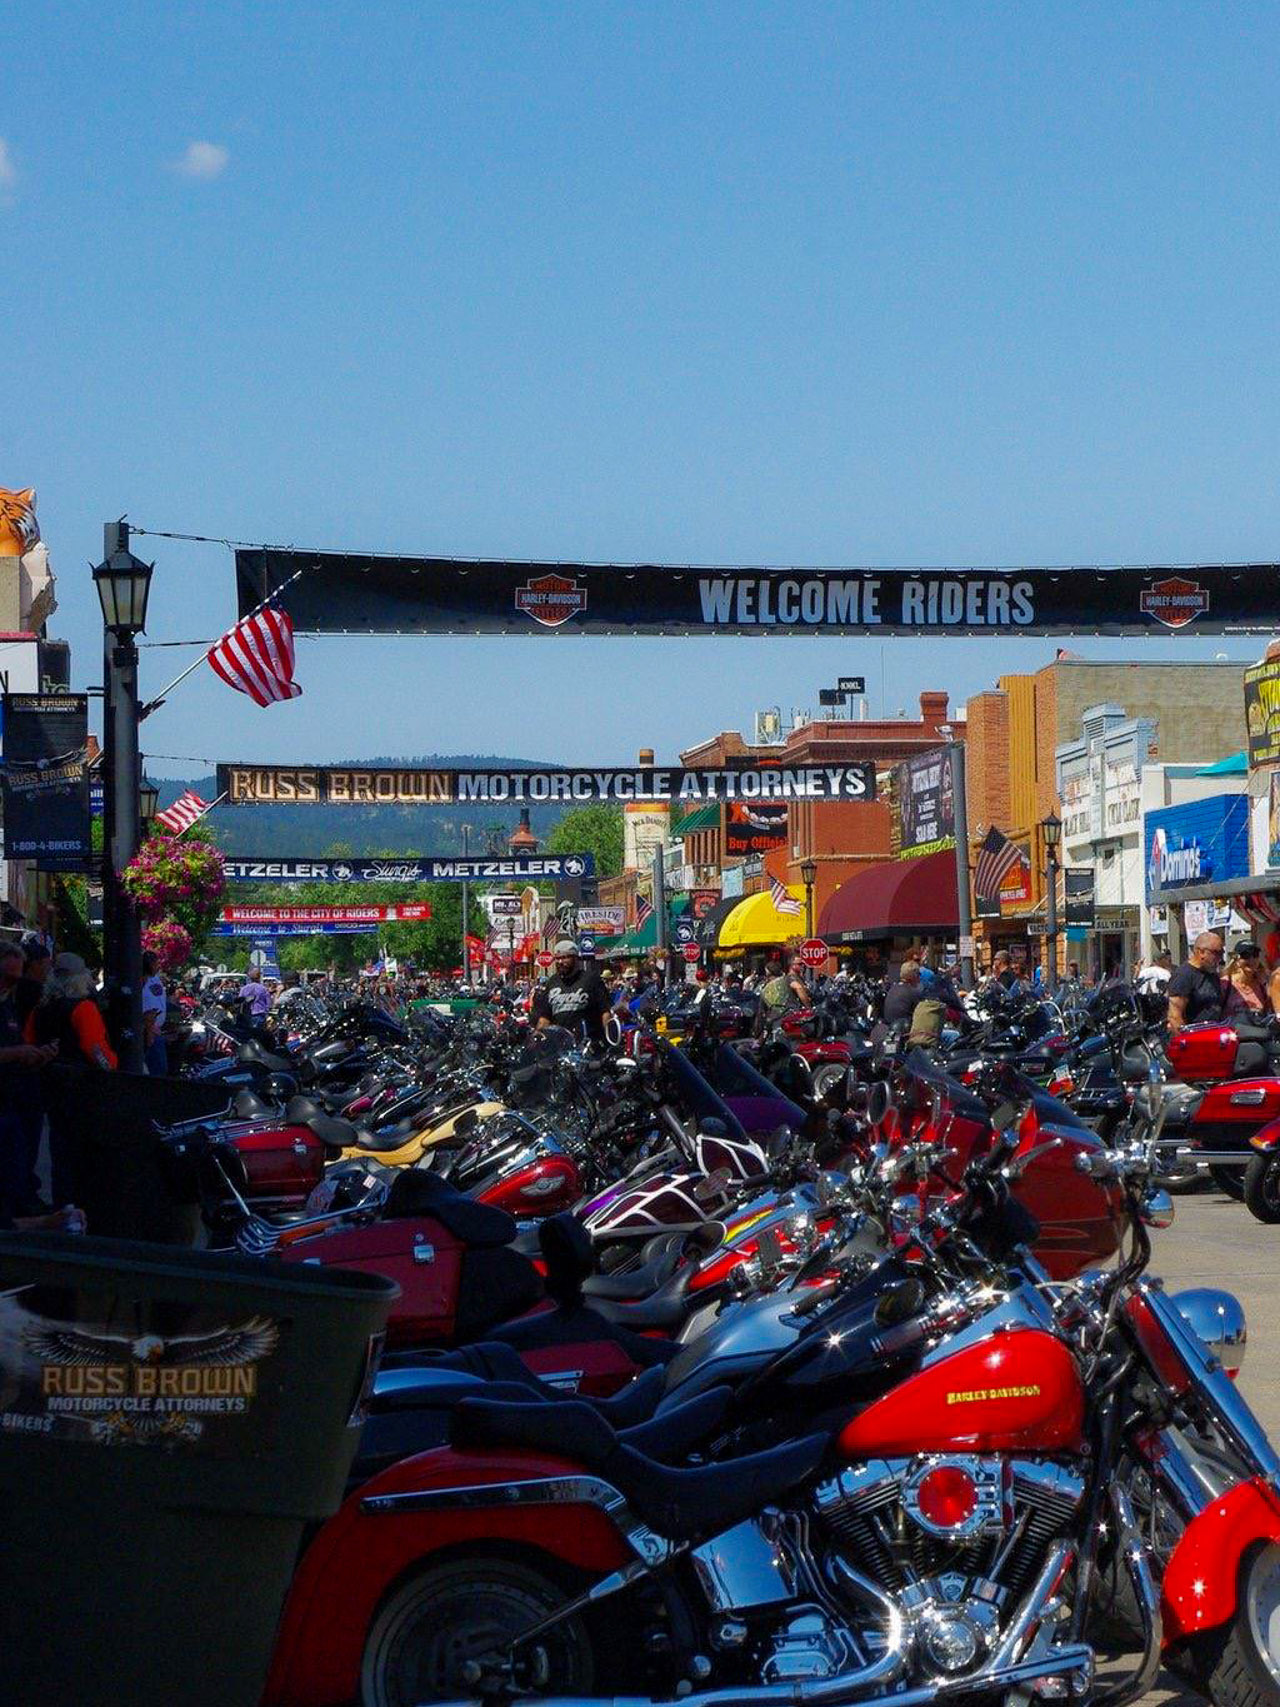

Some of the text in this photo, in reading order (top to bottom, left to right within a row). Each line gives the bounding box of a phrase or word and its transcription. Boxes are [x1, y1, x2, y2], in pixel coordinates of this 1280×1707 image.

[699, 579, 1034, 625] WELCOME RIDERS
[42, 763, 84, 781] BROWN
[230, 768, 866, 802] RUSS BROWN MOTORCYCLE ATTORNEYS
[12, 840, 82, 851] 1-800-4-BIKERS
[729, 837, 748, 850] Buy
[223, 862, 329, 878] ETZELER
[433, 860, 561, 877] METZELER
[232, 907, 380, 919] WELCOME TO THE CITY OF RIDERS
[579, 911, 621, 926] IRESIDE
[802, 947, 827, 959] STOP
[42, 1365, 257, 1396] RUSS BROWN
[946, 1384, 1041, 1405] HARLEY-DAVIDSON
[48, 1397, 246, 1412] MOTORCYCLE ATTORNEYS
